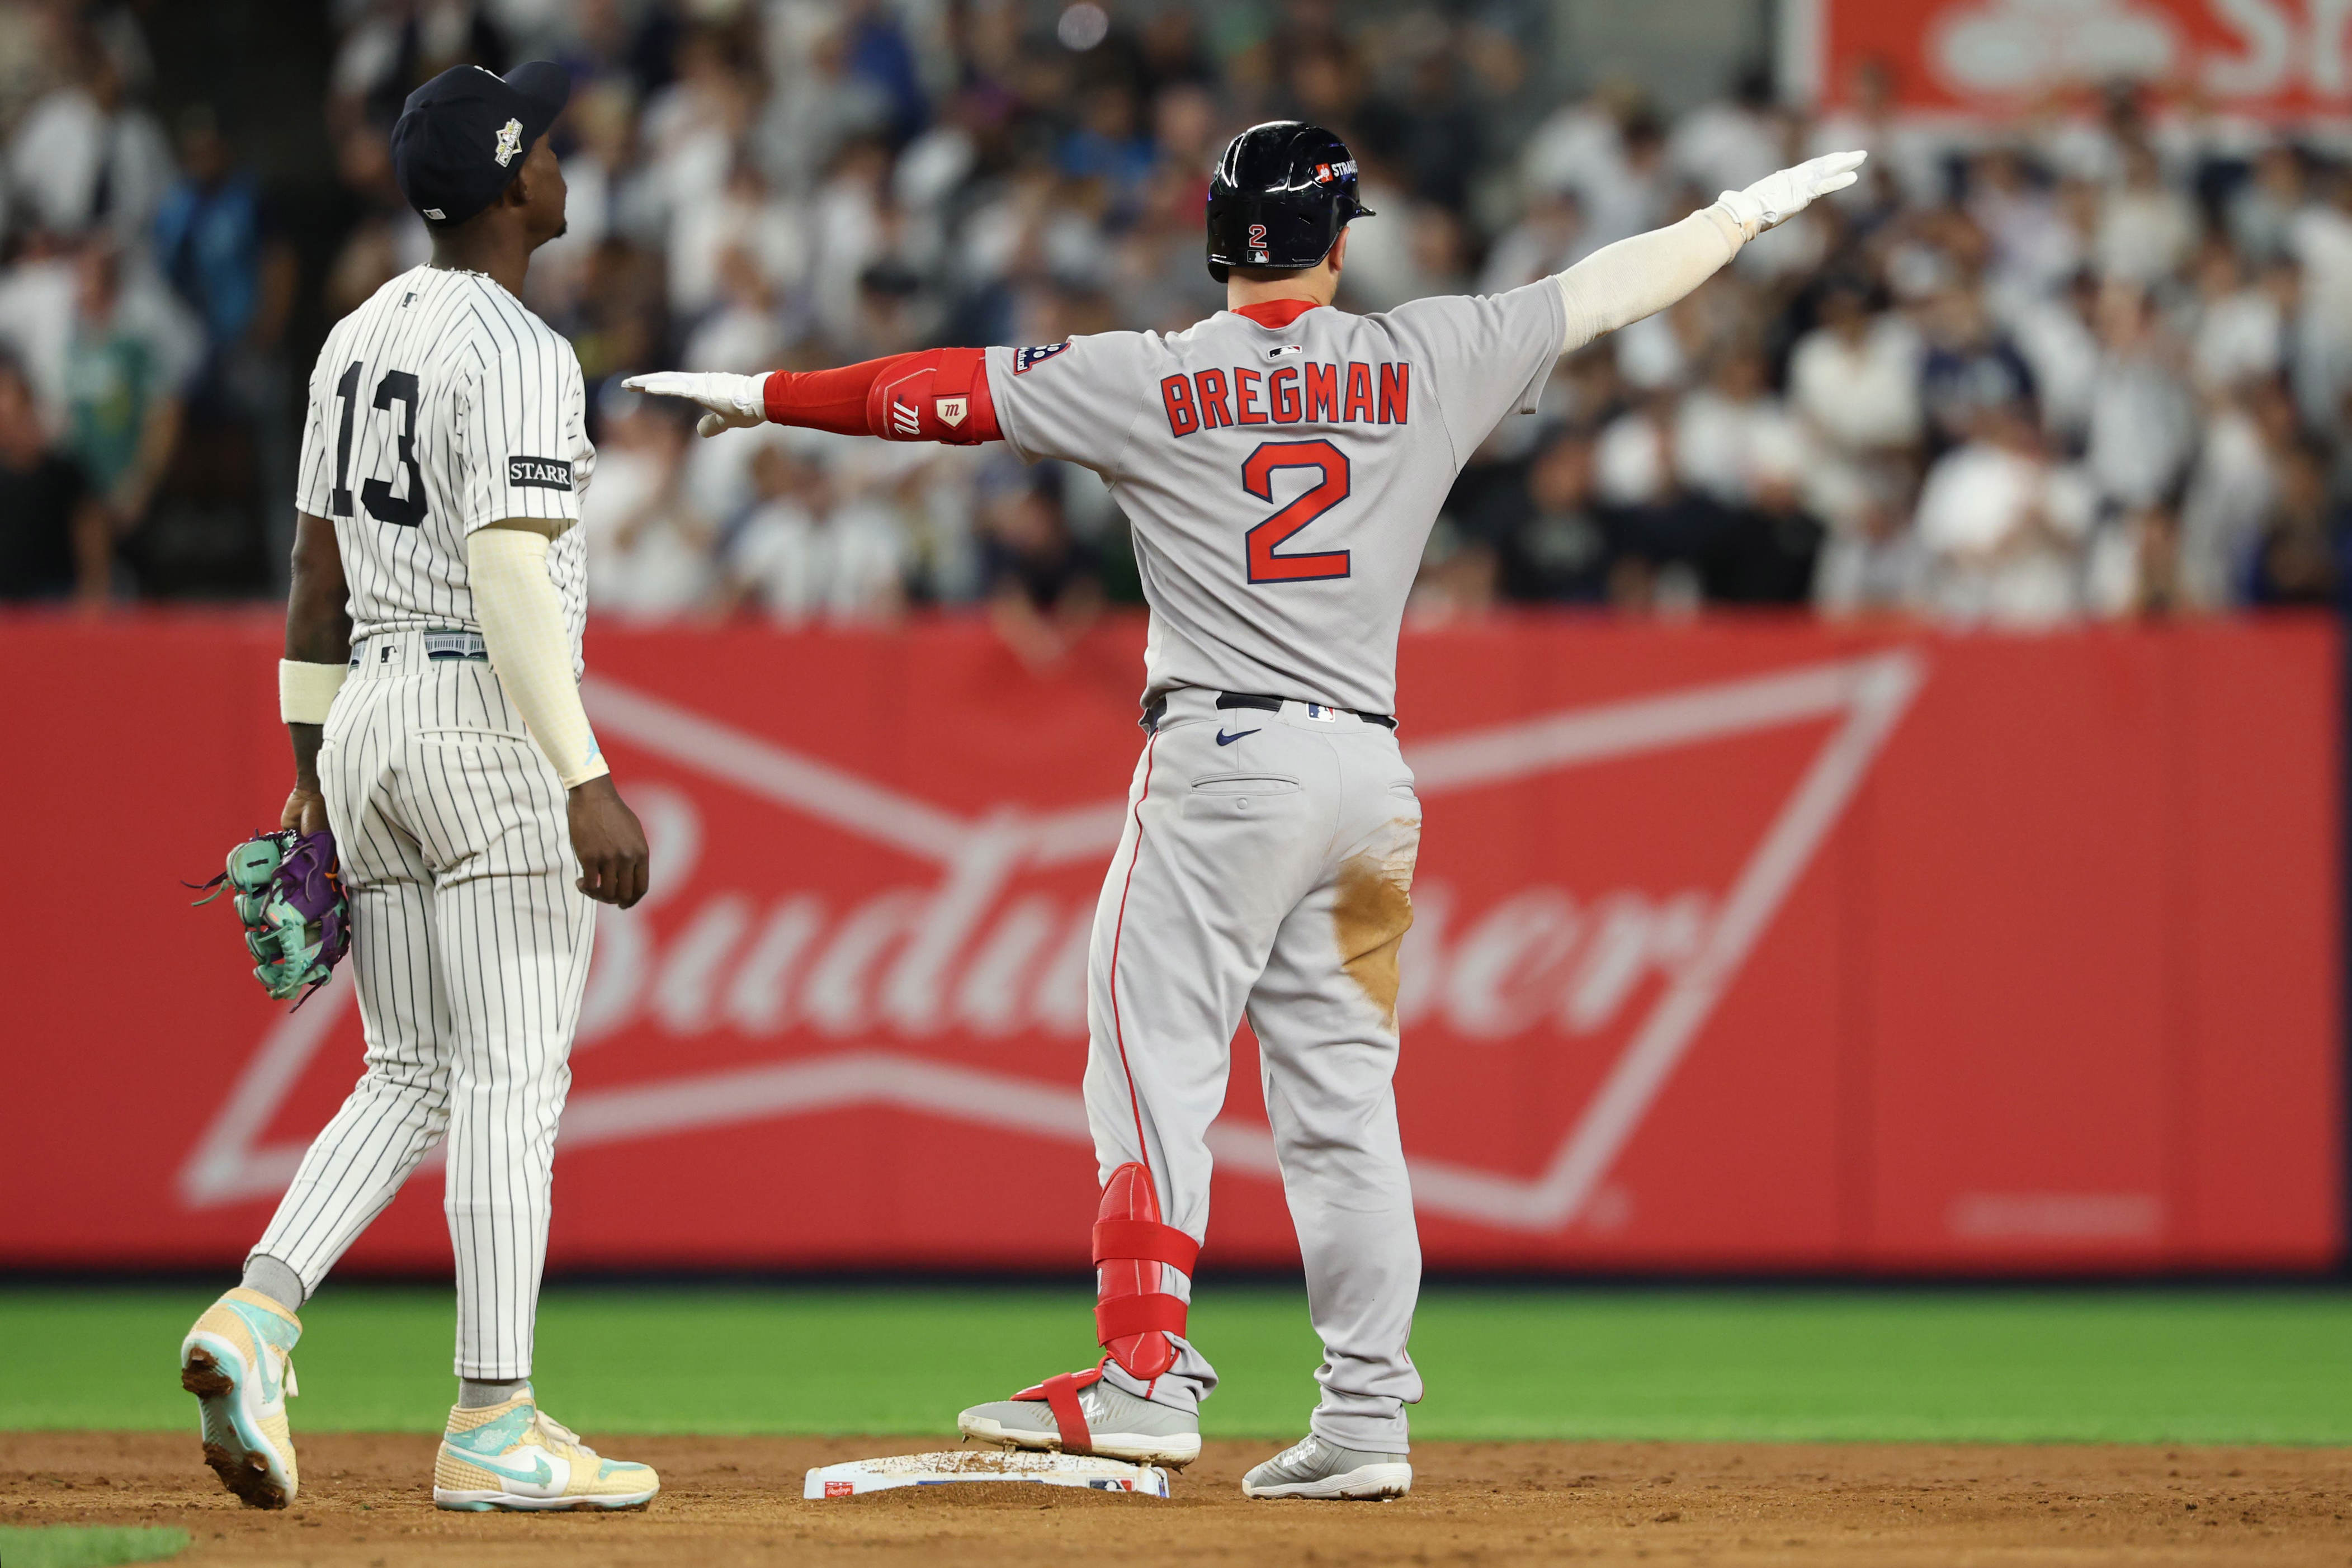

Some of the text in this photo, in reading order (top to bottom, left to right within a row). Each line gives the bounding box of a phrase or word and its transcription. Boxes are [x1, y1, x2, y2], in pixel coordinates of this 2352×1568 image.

[498, 121, 521, 164] POSTSEASON
[1249, 224, 1267, 248] 2
[1160, 361, 1410, 438] BREGMAN
[332, 361, 428, 528] 13
[510, 462, 570, 485] STARR
[1241, 438, 1350, 584] 2
[827, 1486, 851, 1496] Rawlings
